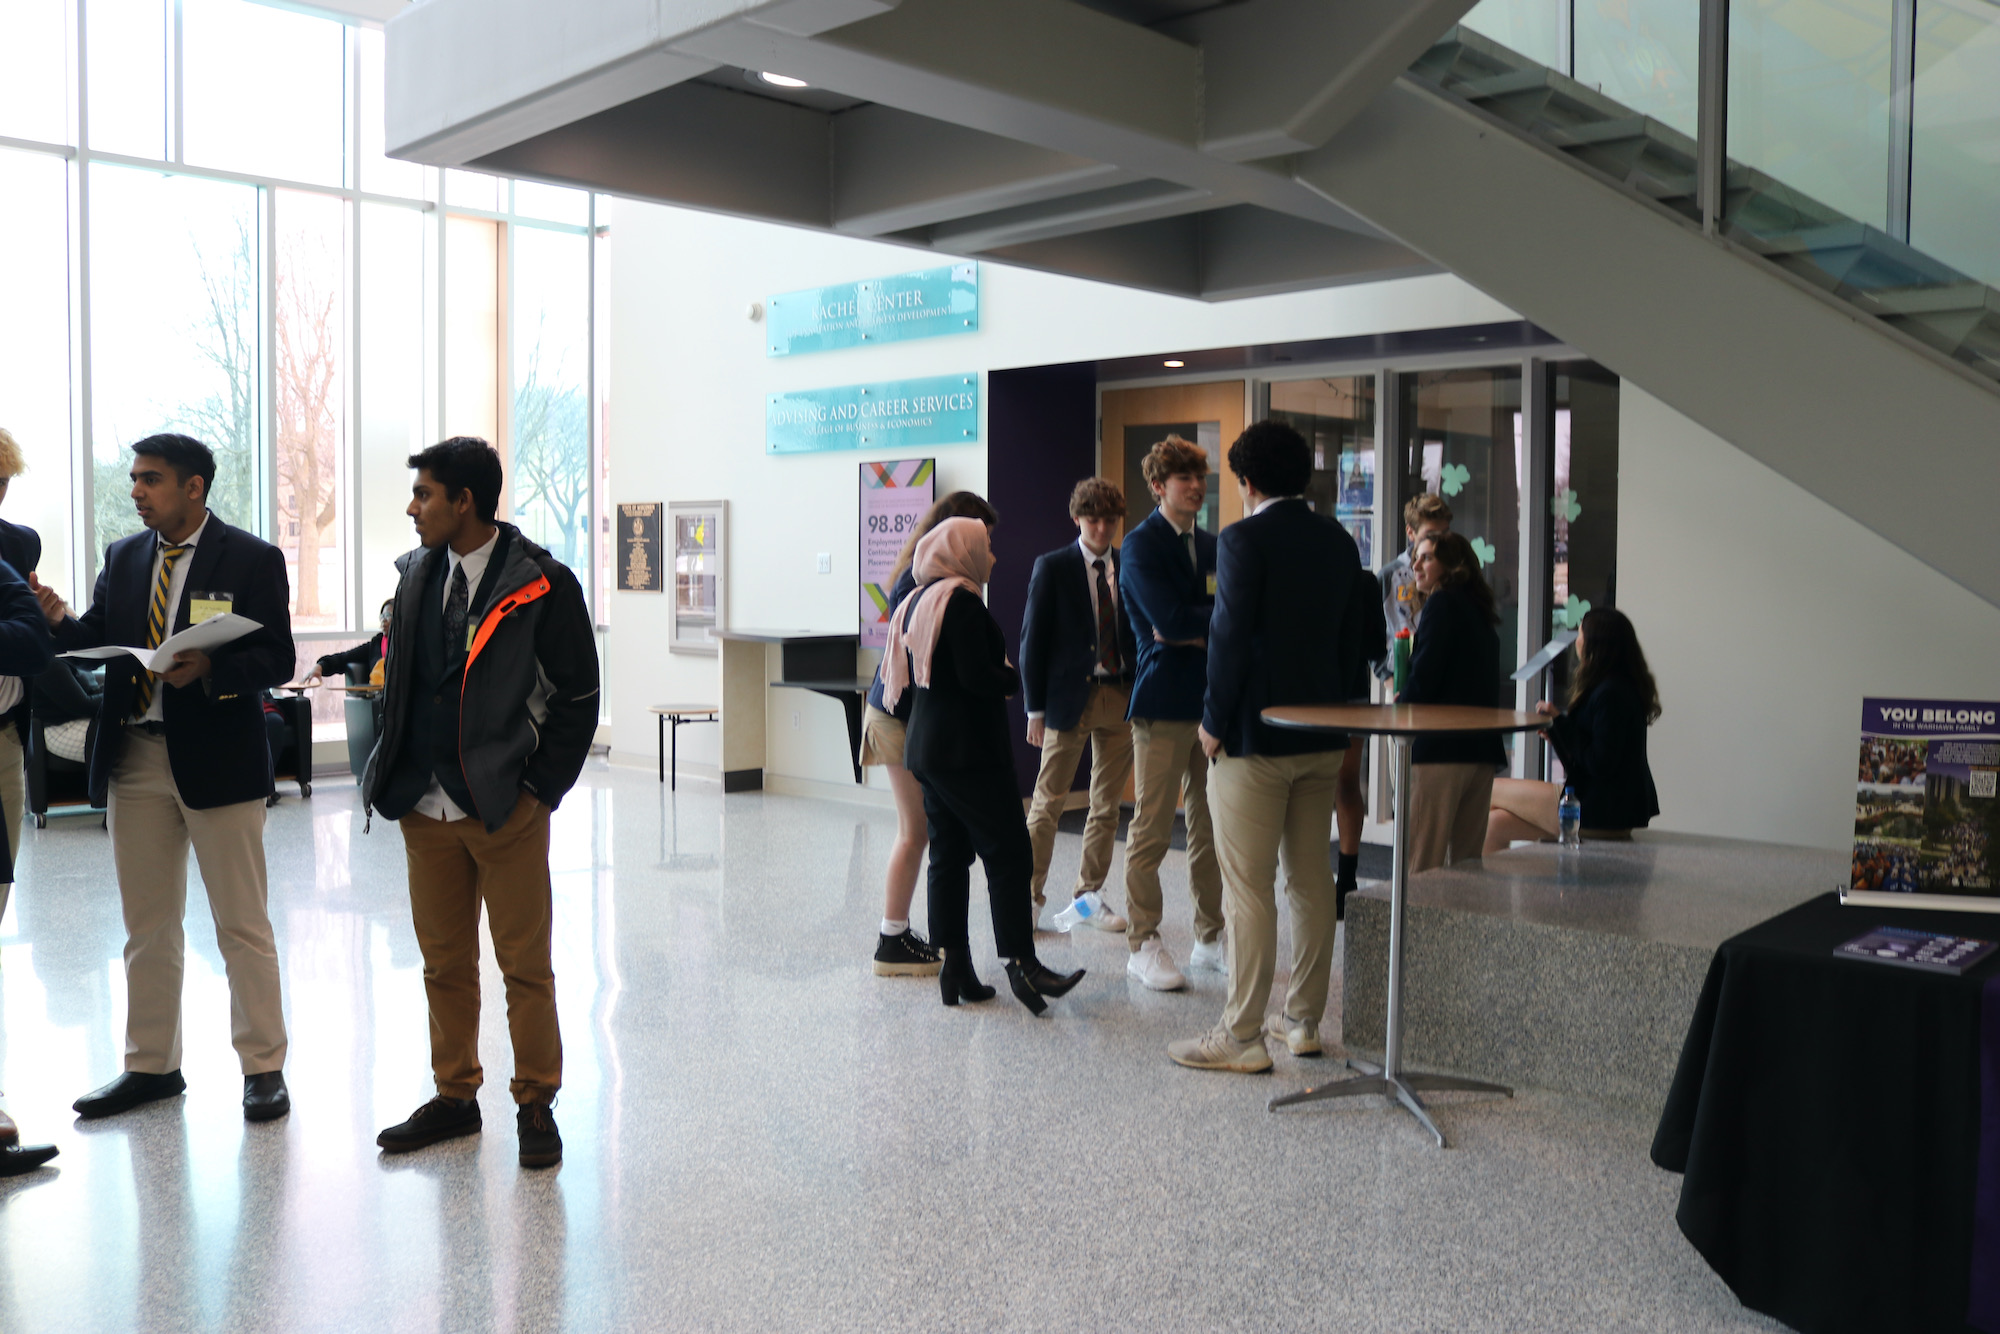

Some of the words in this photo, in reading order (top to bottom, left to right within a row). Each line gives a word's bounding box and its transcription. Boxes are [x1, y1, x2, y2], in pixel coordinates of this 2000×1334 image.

[866, 289, 923, 312] CENTER
[897, 305, 952, 321] DEVELOPMENT
[771, 405, 826, 426] ADVISING
[830, 403, 858, 421] AND
[861, 398, 909, 418] CAREER
[912, 392, 974, 414] SERVICES
[835, 423, 844, 433] OF
[846, 420, 879, 433] BUSINESS
[887, 417, 933, 429] ECONOMICS
[868, 513, 919, 533] 98.8%
[868, 538, 902, 547] Employment
[868, 548, 898, 558] Continuing
[1880, 707, 1918, 722] YOU
[1922, 708, 1996, 725] BELONG
[1892, 722, 1901, 730] IN
[1902, 722, 1914, 730] THE
[1916, 723, 1954, 731] WARHAWK
[1956, 724, 1981, 732] FAMILY
